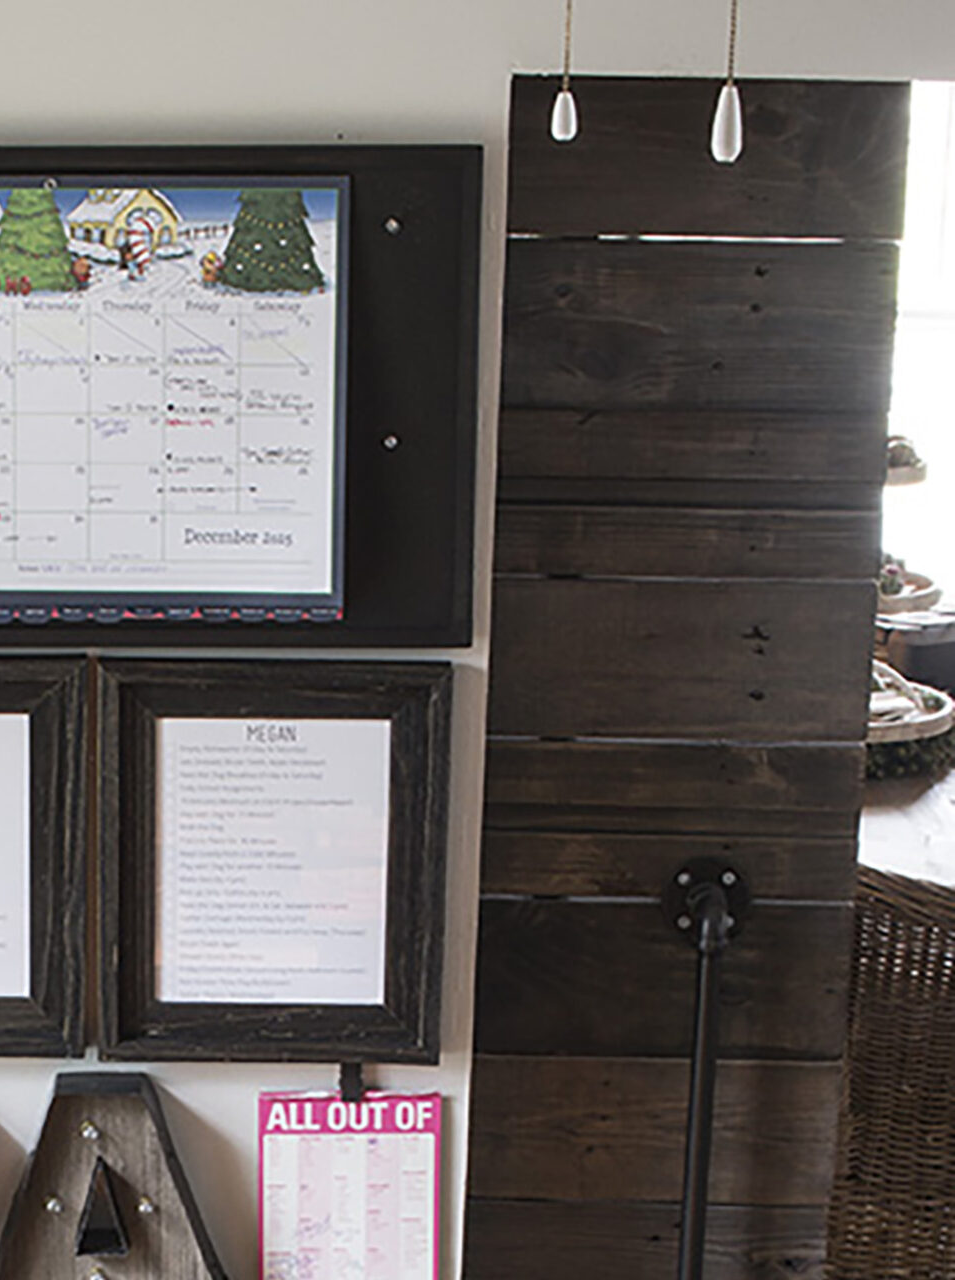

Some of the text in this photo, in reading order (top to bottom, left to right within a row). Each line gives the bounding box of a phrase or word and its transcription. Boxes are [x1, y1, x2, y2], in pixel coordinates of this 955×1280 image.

[185, 300, 221, 315] Friday
[184, 527, 259, 545] December
[246, 724, 298, 743] MEGAN
[265, 1101, 433, 1131] ALL OUT OF
